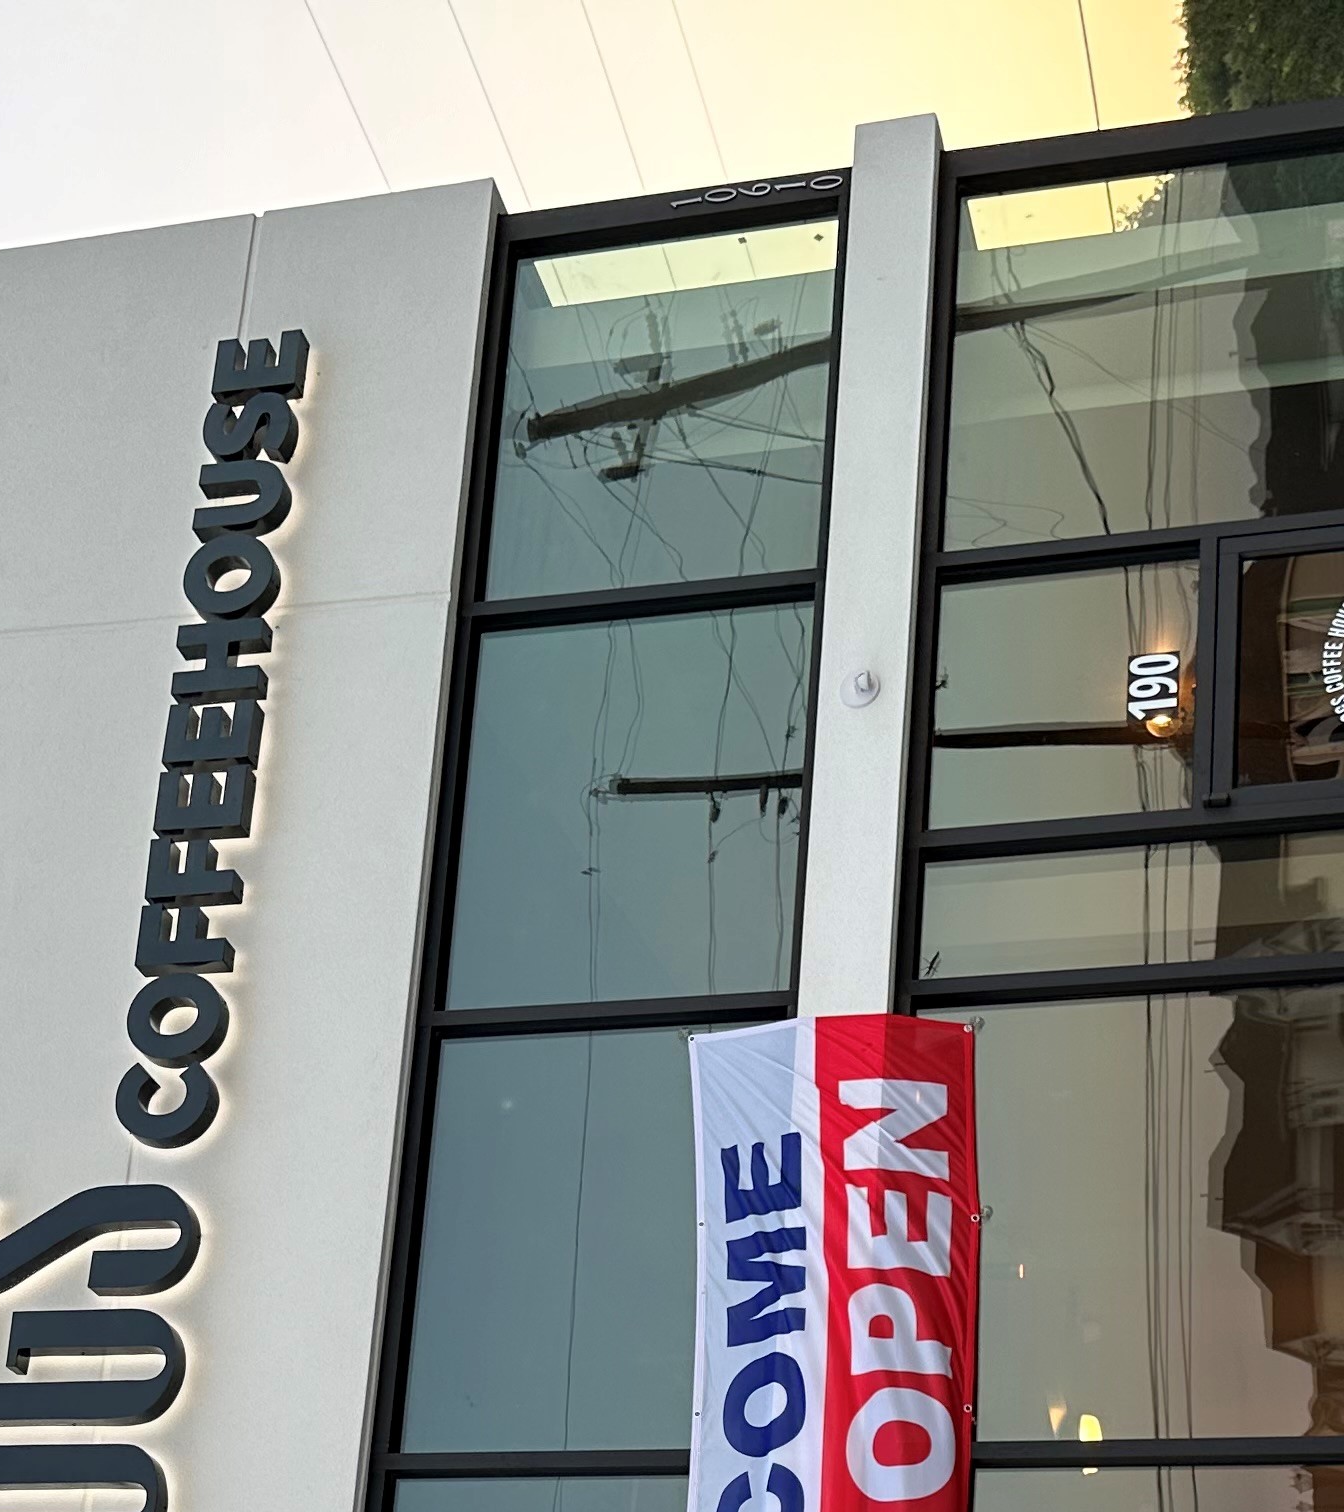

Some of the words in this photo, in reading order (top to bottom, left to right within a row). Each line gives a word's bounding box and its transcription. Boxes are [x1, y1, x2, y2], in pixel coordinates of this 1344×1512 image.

[670, 174, 844, 209] 10610
[114, 329, 309, 1149] COFFEEHOUSE
[1128, 653, 1180, 720] 190
[837, 1079, 955, 1502] OPEN
